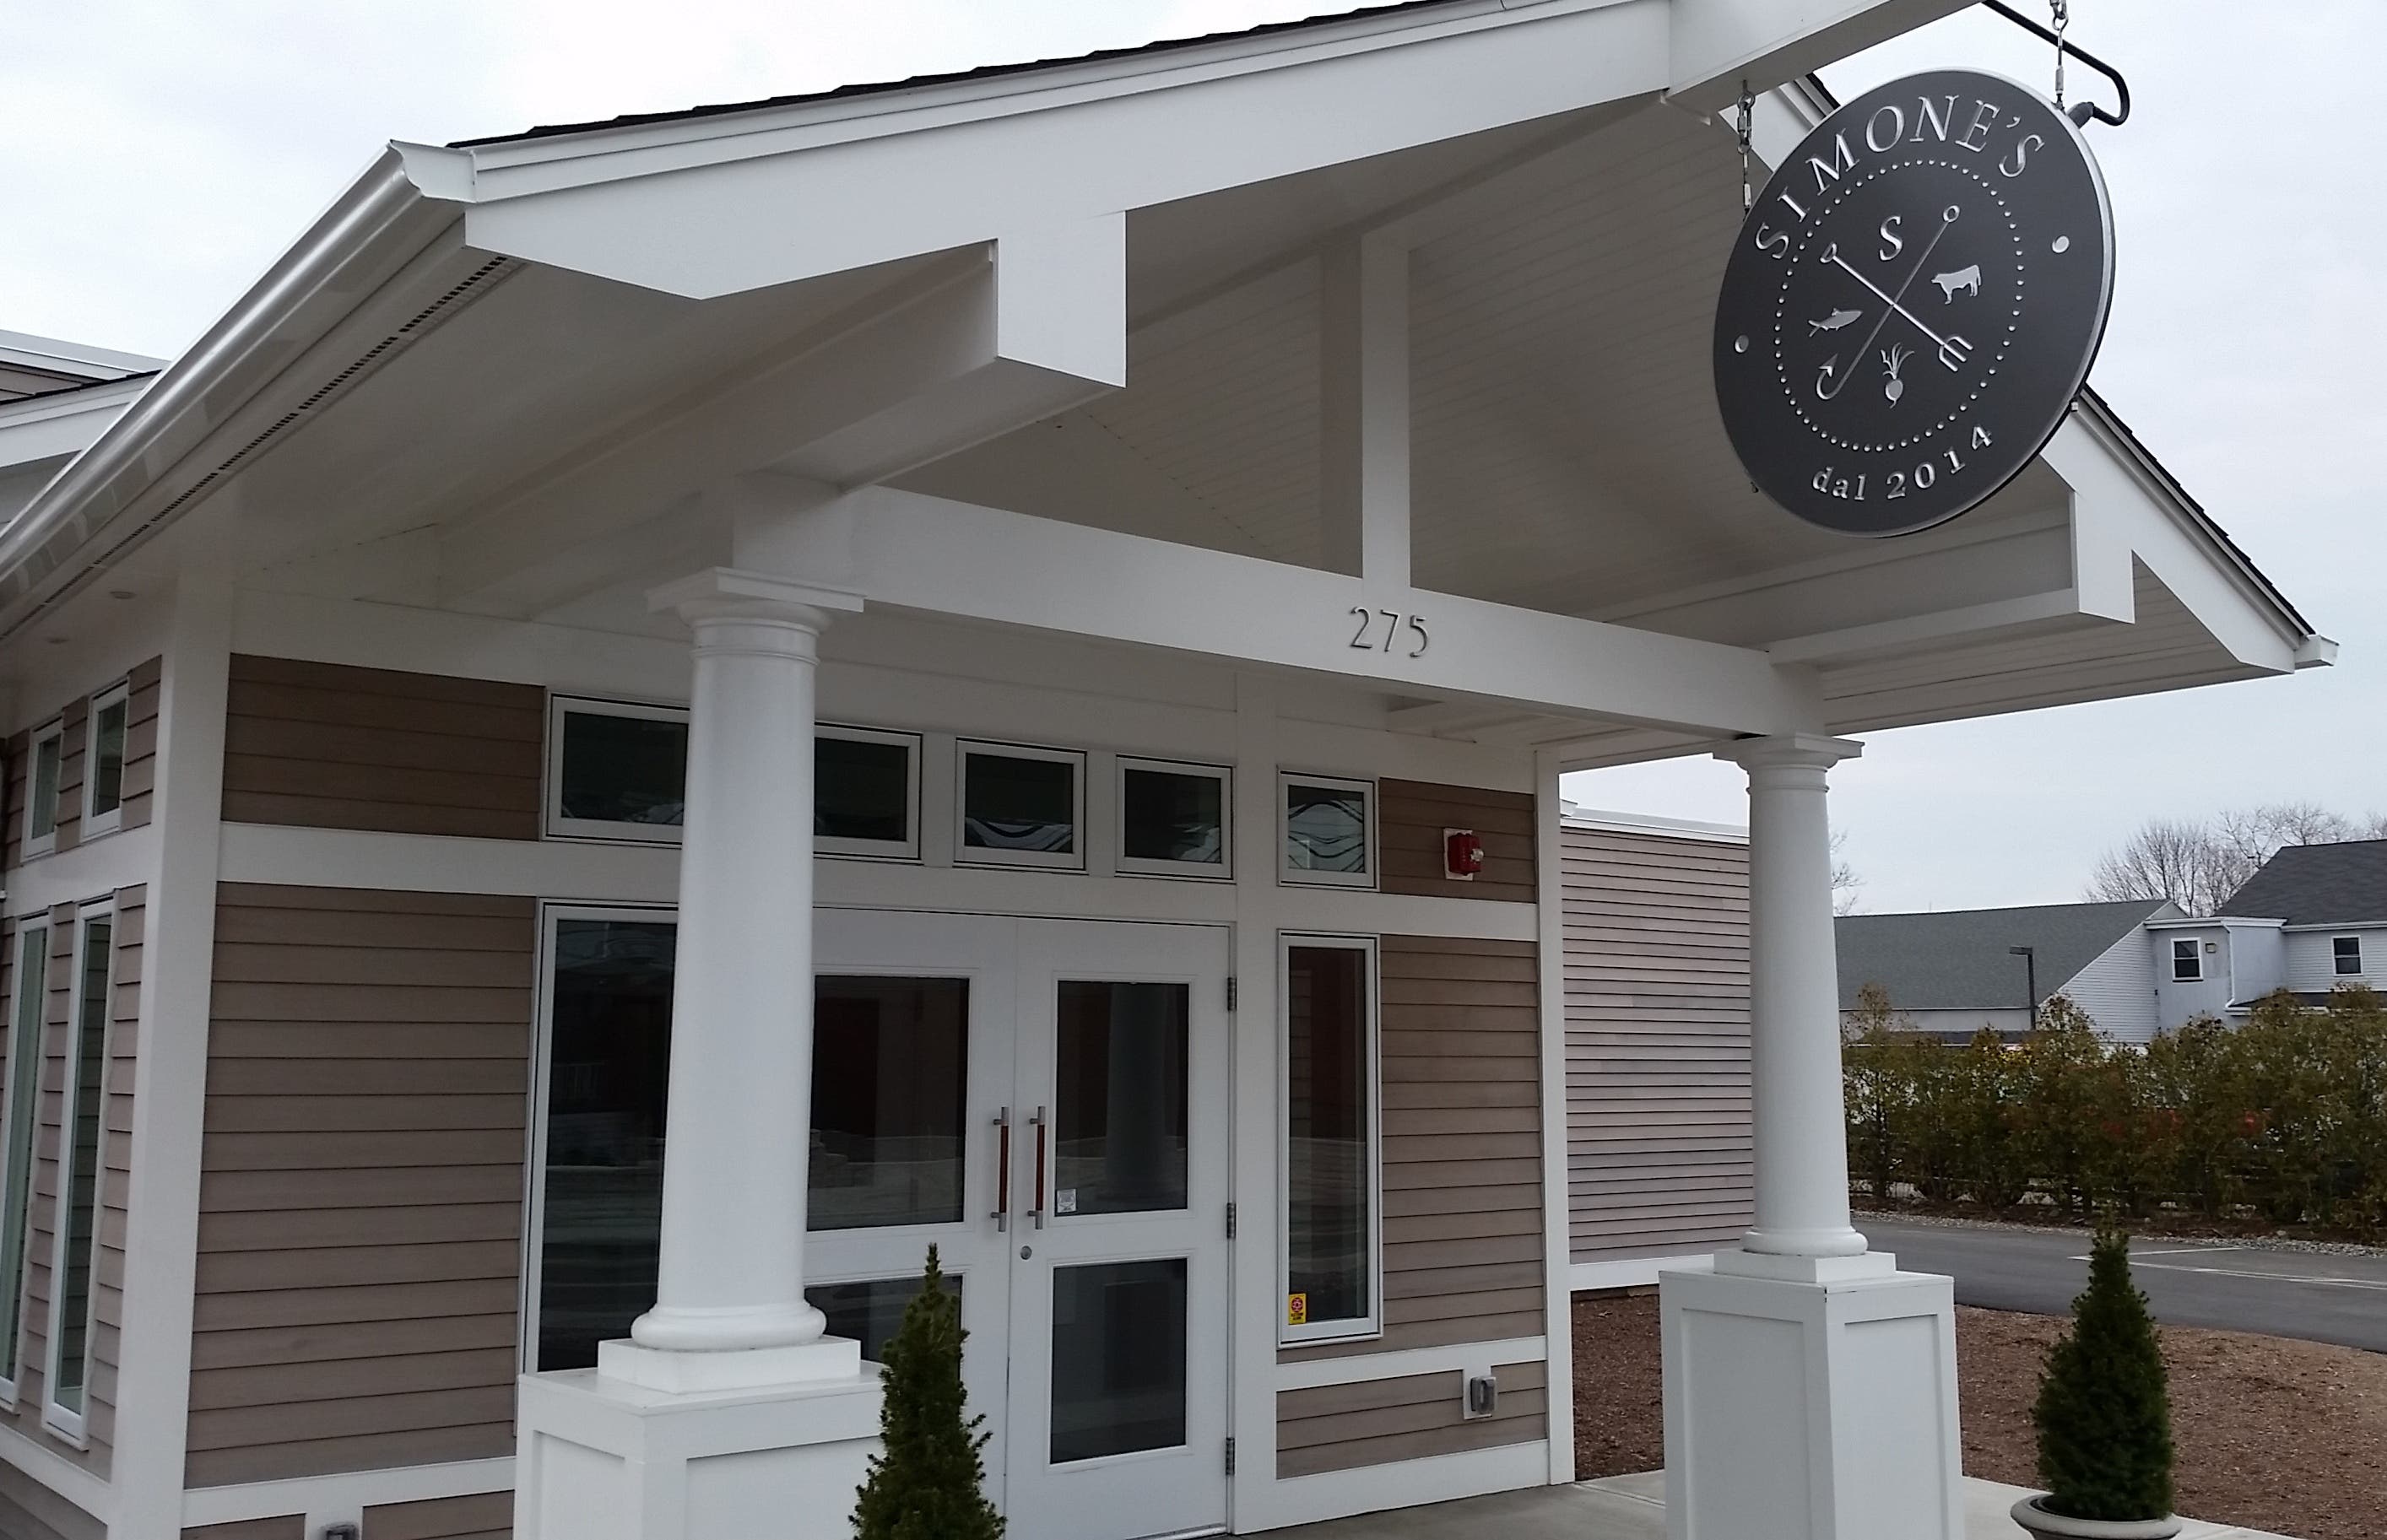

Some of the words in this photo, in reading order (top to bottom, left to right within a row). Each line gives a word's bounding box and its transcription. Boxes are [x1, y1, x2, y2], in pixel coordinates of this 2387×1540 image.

[1756, 95, 2045, 259] SIMONE'S
[1879, 215, 1903, 261] S
[1812, 466, 1865, 500] dal
[1886, 424, 1993, 500] 2014
[1350, 606, 1428, 657] 275
